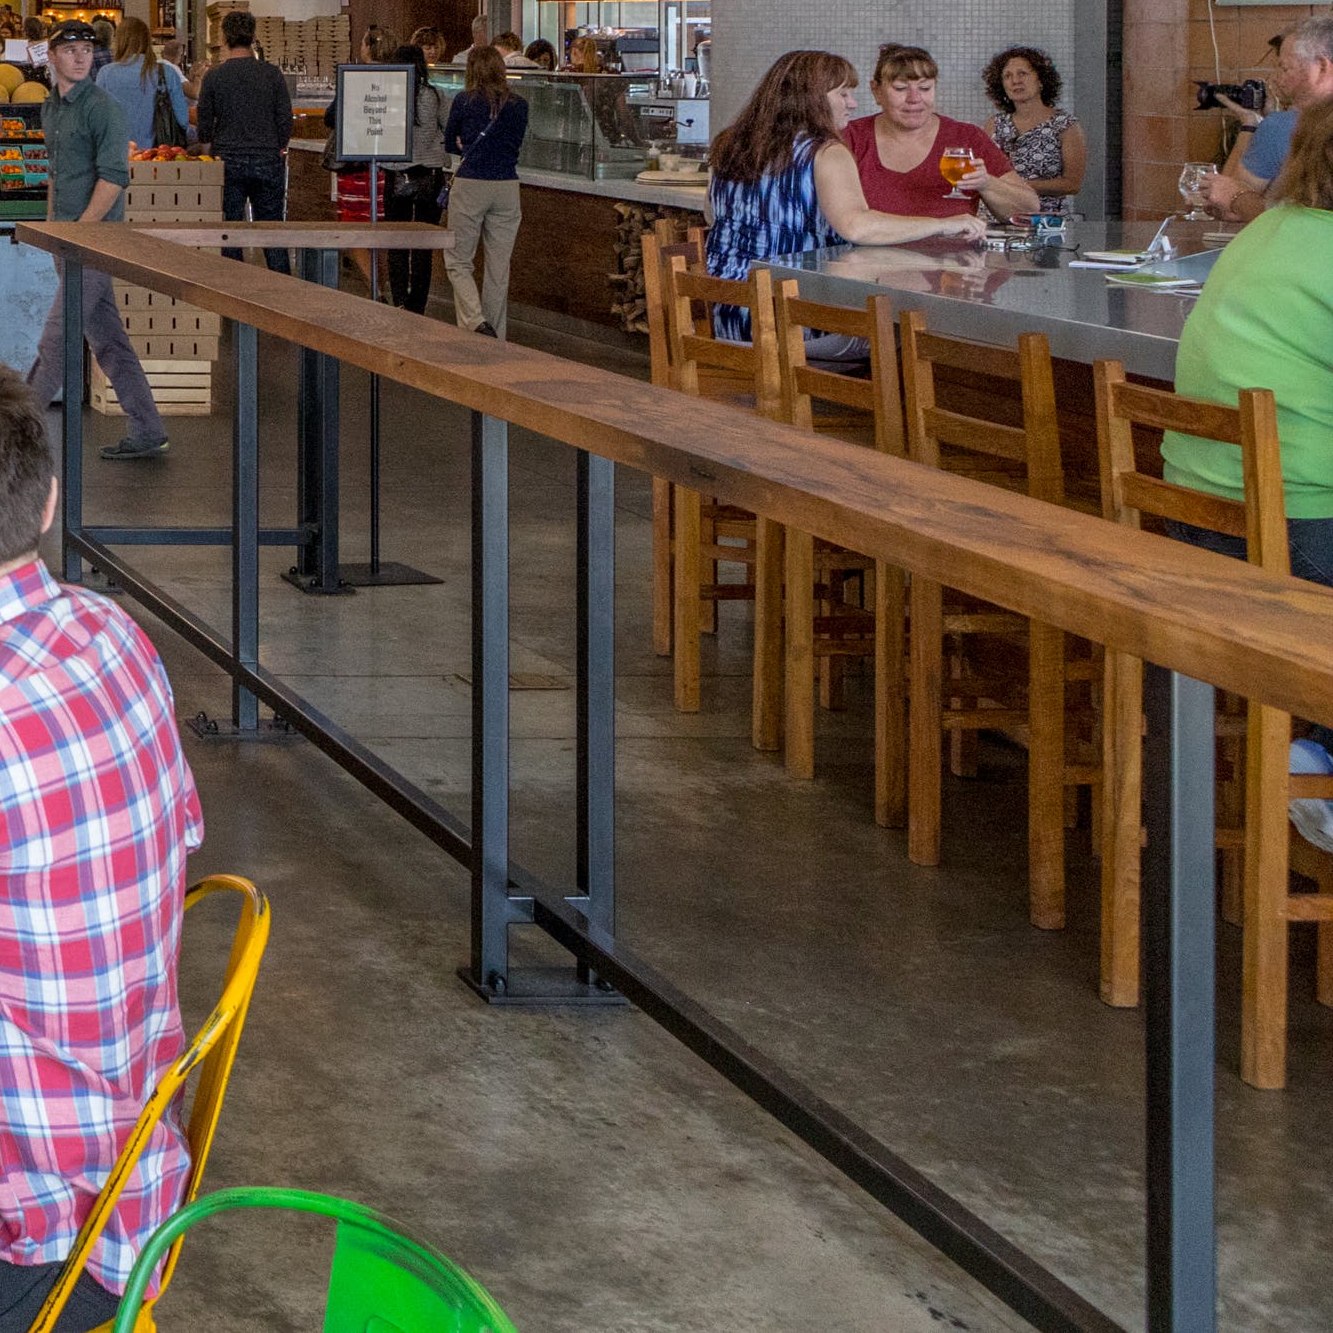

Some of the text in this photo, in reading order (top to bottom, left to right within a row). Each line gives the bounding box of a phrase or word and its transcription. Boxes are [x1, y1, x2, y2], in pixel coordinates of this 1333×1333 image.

[371, 83, 380, 91] No
[364, 94, 387, 103] Alcohol
[363, 106, 387, 114] Beyond
[368, 116, 381, 125] This
[366, 128, 383, 136] Point
